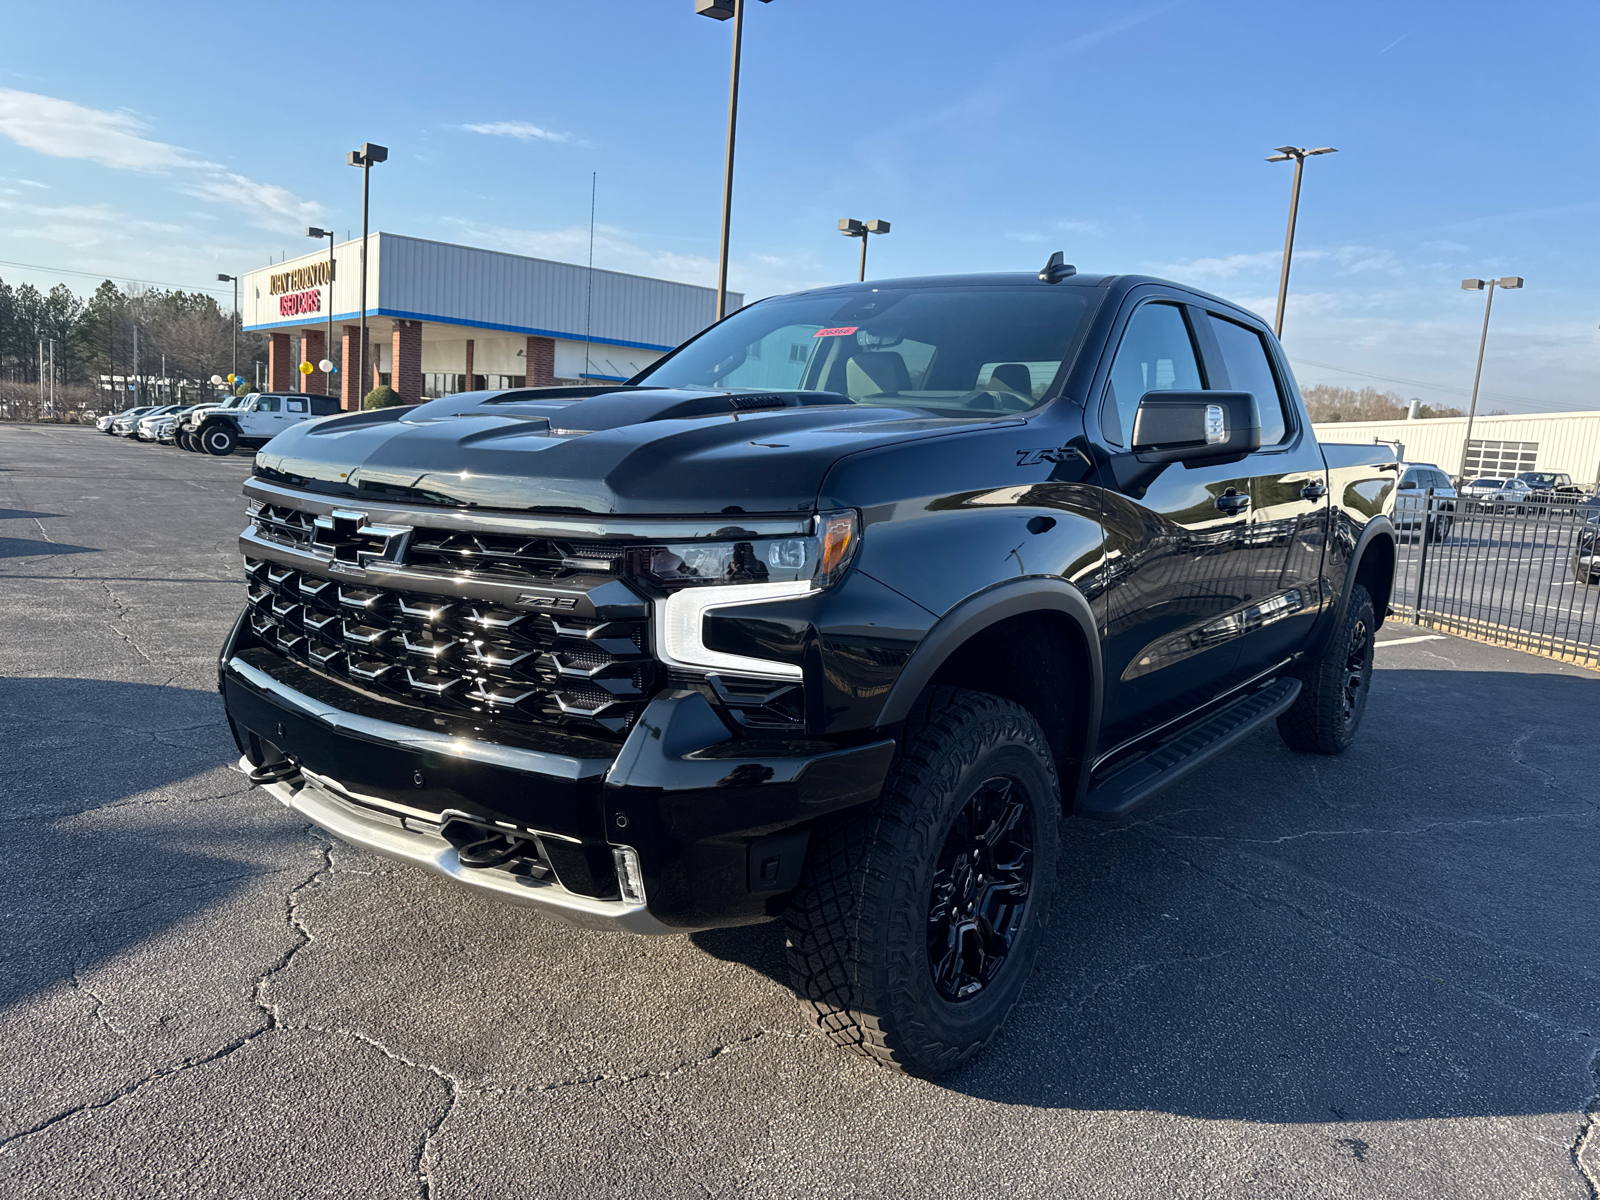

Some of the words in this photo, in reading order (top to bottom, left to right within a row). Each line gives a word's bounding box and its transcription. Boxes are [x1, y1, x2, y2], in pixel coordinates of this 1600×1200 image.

[279, 293, 299, 316] USED
[298, 288, 321, 313] CARS
[1016, 446, 1078, 466] ZR2
